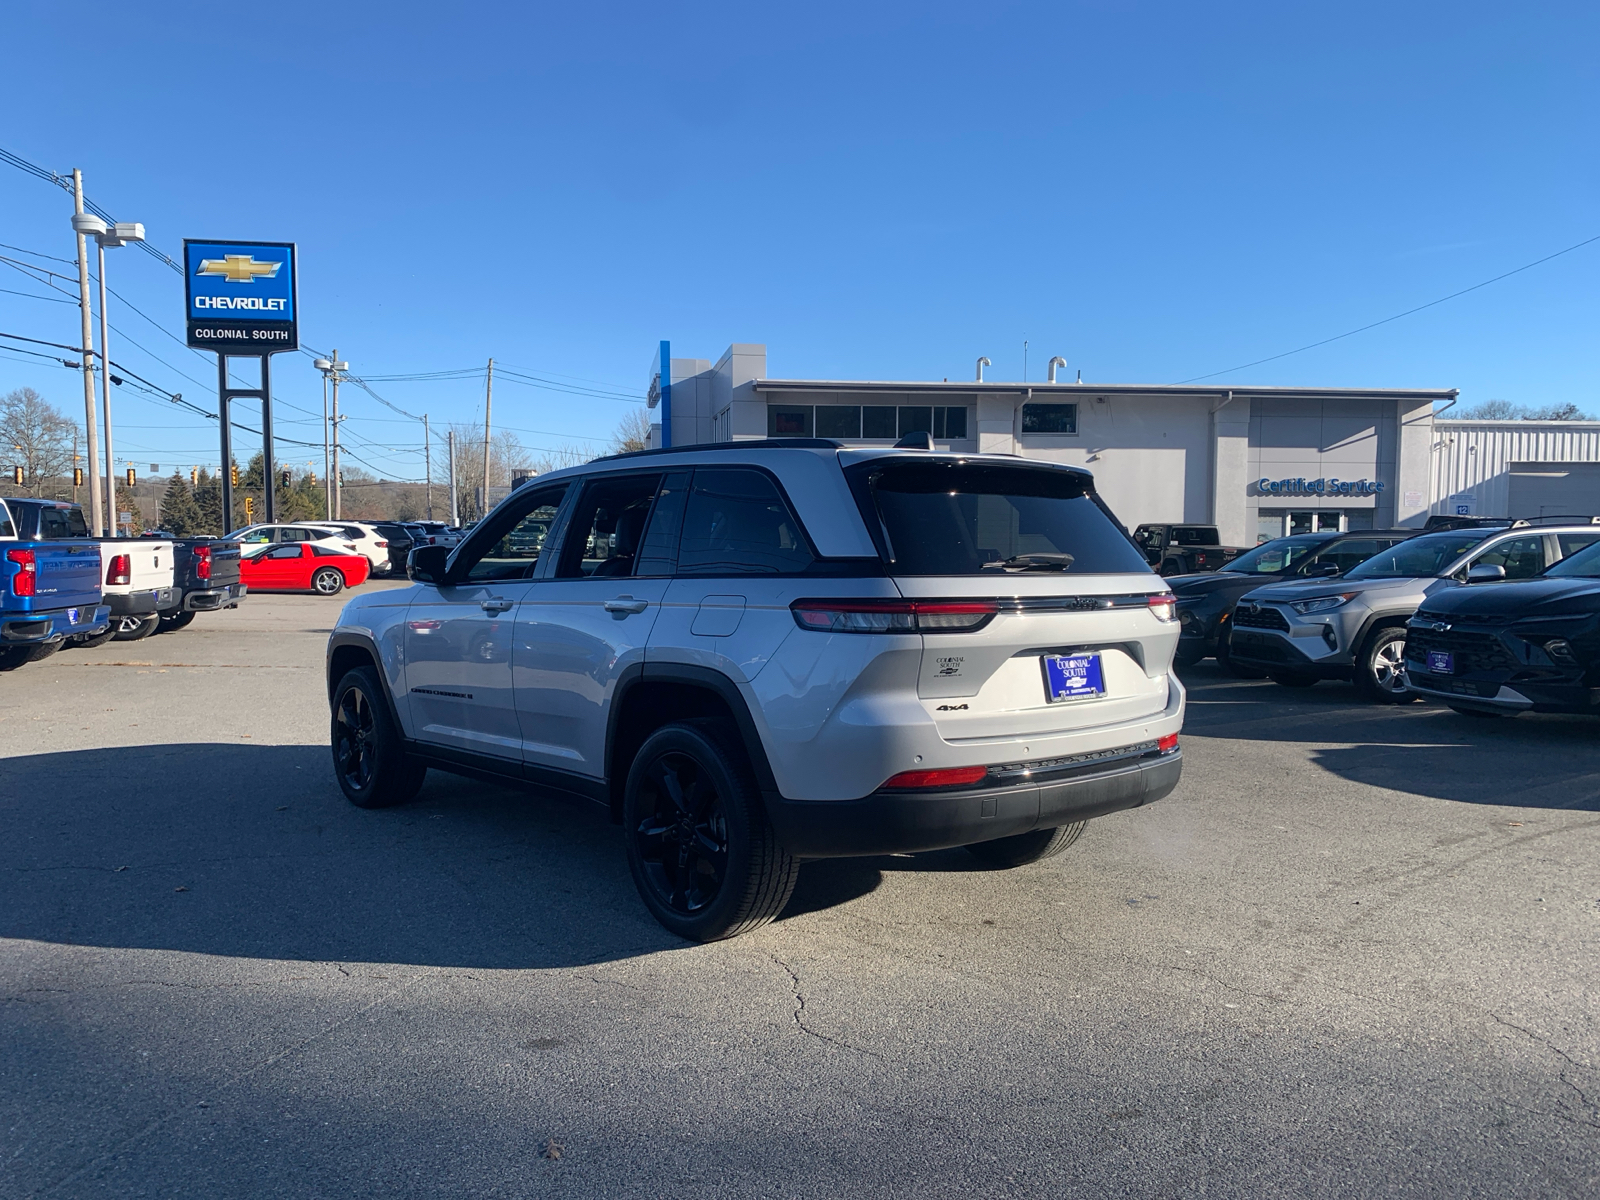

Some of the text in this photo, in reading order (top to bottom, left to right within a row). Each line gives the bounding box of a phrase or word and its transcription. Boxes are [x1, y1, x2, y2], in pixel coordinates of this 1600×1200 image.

[194, 296, 287, 311] CHEVROLET
[195, 328, 288, 340] COLONIAL SOUTH
[1258, 477, 1385, 493] Certified Service
[1057, 659, 1090, 669] COLONIAL
[1063, 667, 1086, 678] SOUTH
